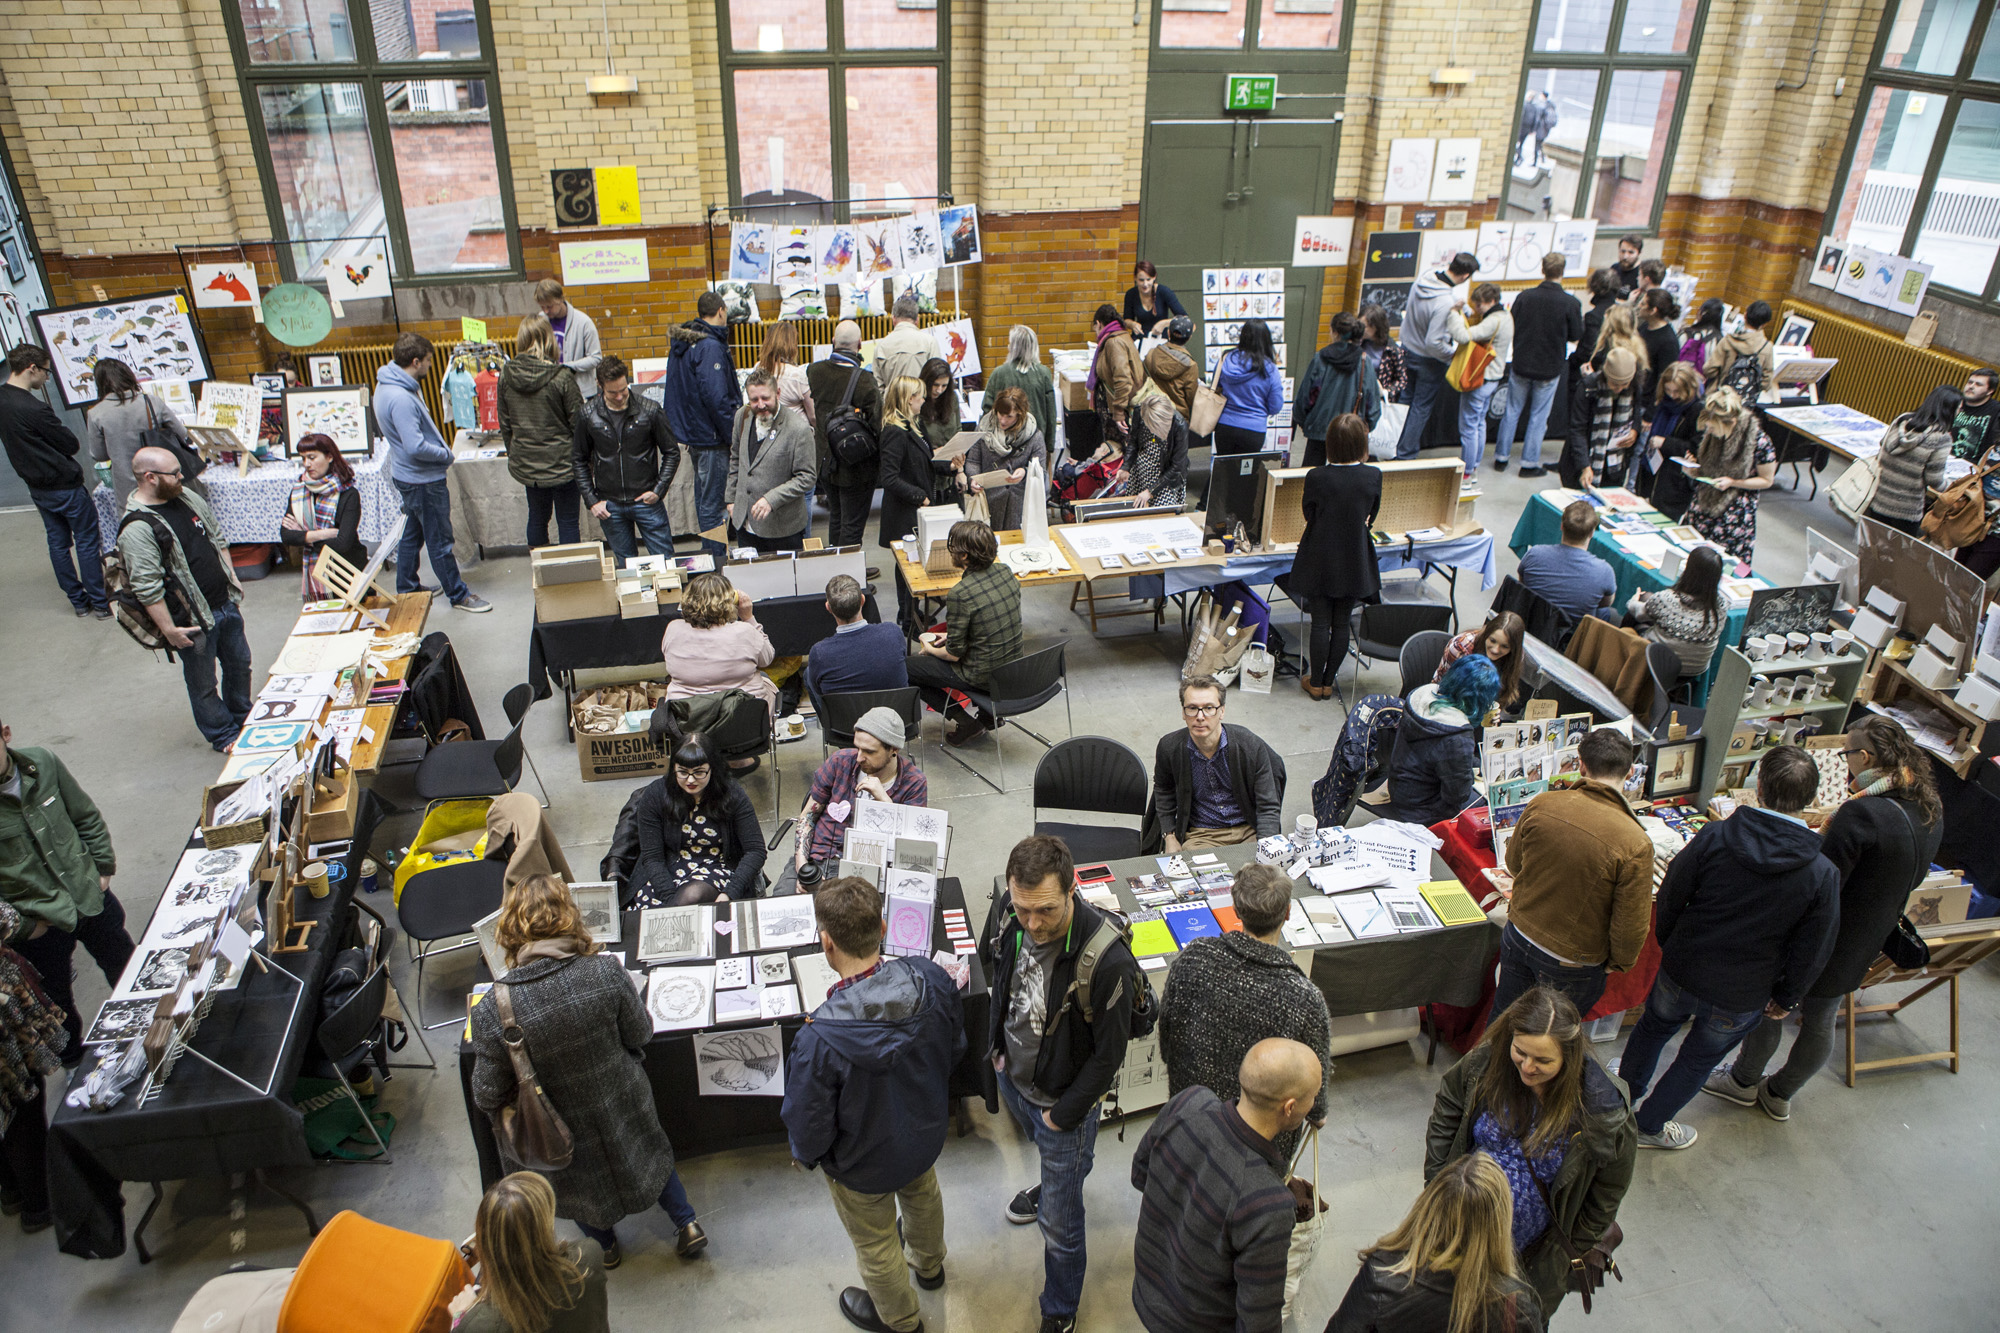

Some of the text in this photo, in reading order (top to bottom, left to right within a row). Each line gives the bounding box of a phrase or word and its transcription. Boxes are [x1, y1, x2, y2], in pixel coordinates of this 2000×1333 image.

[1254, 81, 1270, 90] EXIT
[592, 736, 657, 756] AWESOM
[611, 751, 665, 765] MERCHANDISE
[1376, 842, 1407, 852] Property
[1366, 847, 1408, 858] Information
[1380, 855, 1407, 864] Tickets
[1387, 862, 1407, 870] Taxis
